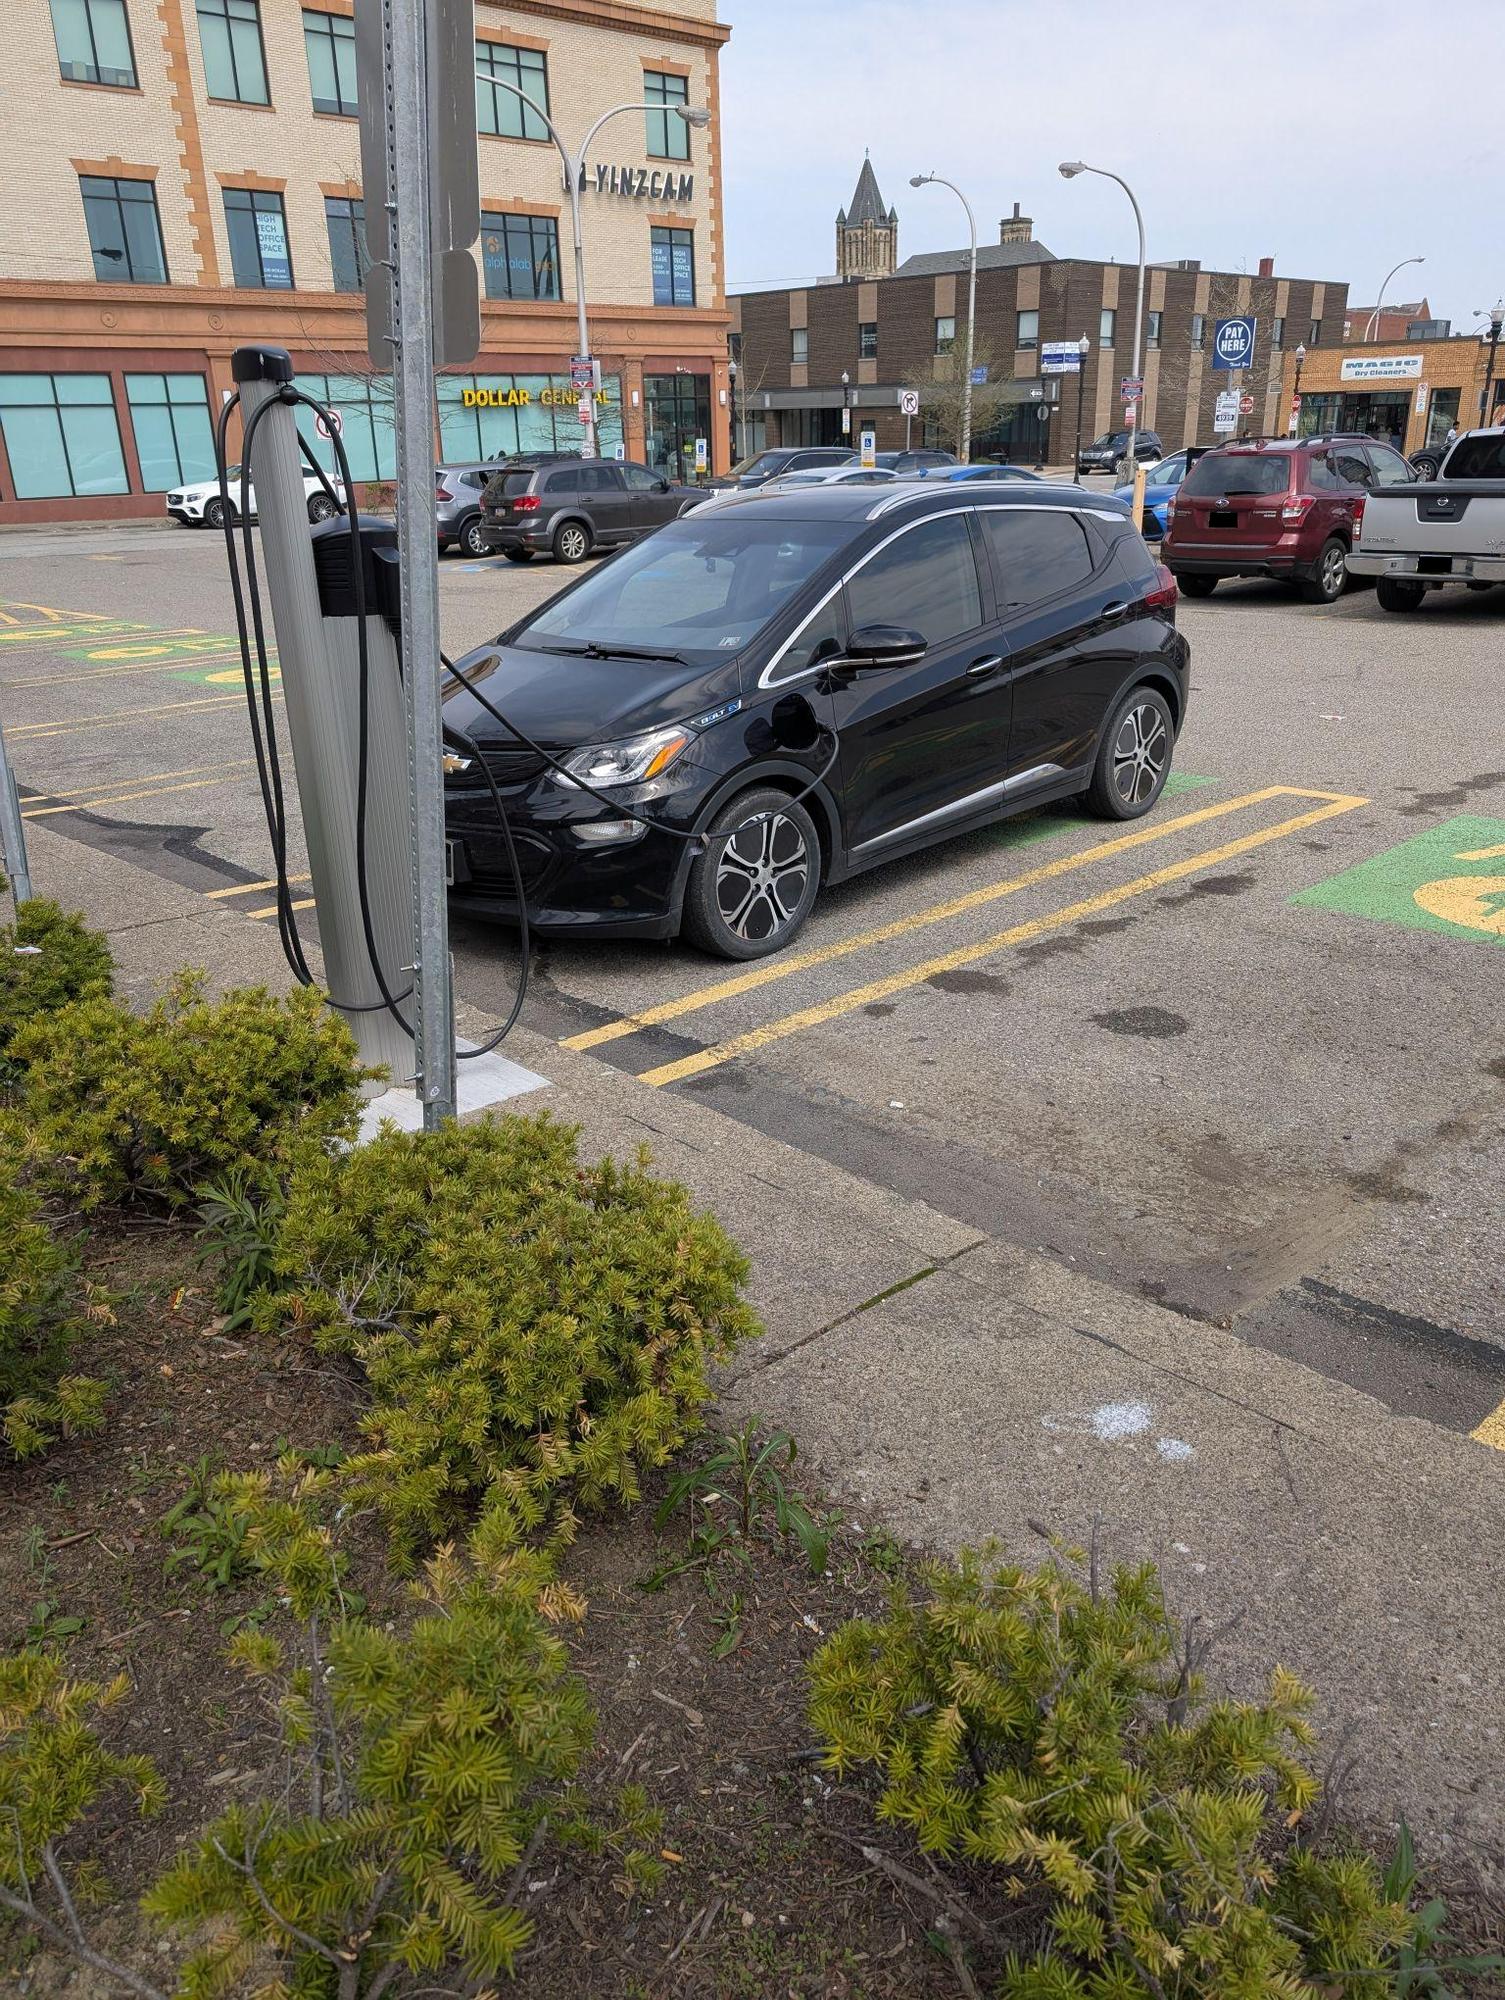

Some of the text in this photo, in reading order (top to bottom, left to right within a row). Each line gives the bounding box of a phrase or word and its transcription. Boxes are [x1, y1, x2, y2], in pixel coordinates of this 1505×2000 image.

[596, 164, 694, 202] YINZCAM
[258, 224, 277, 233] ECH
[1225, 326, 1244, 339] PAY
[1221, 339, 1246, 352] HERE
[1345, 360, 1418, 369] MAGIC
[462, 388, 611, 407] DOLLAR GENEAL
